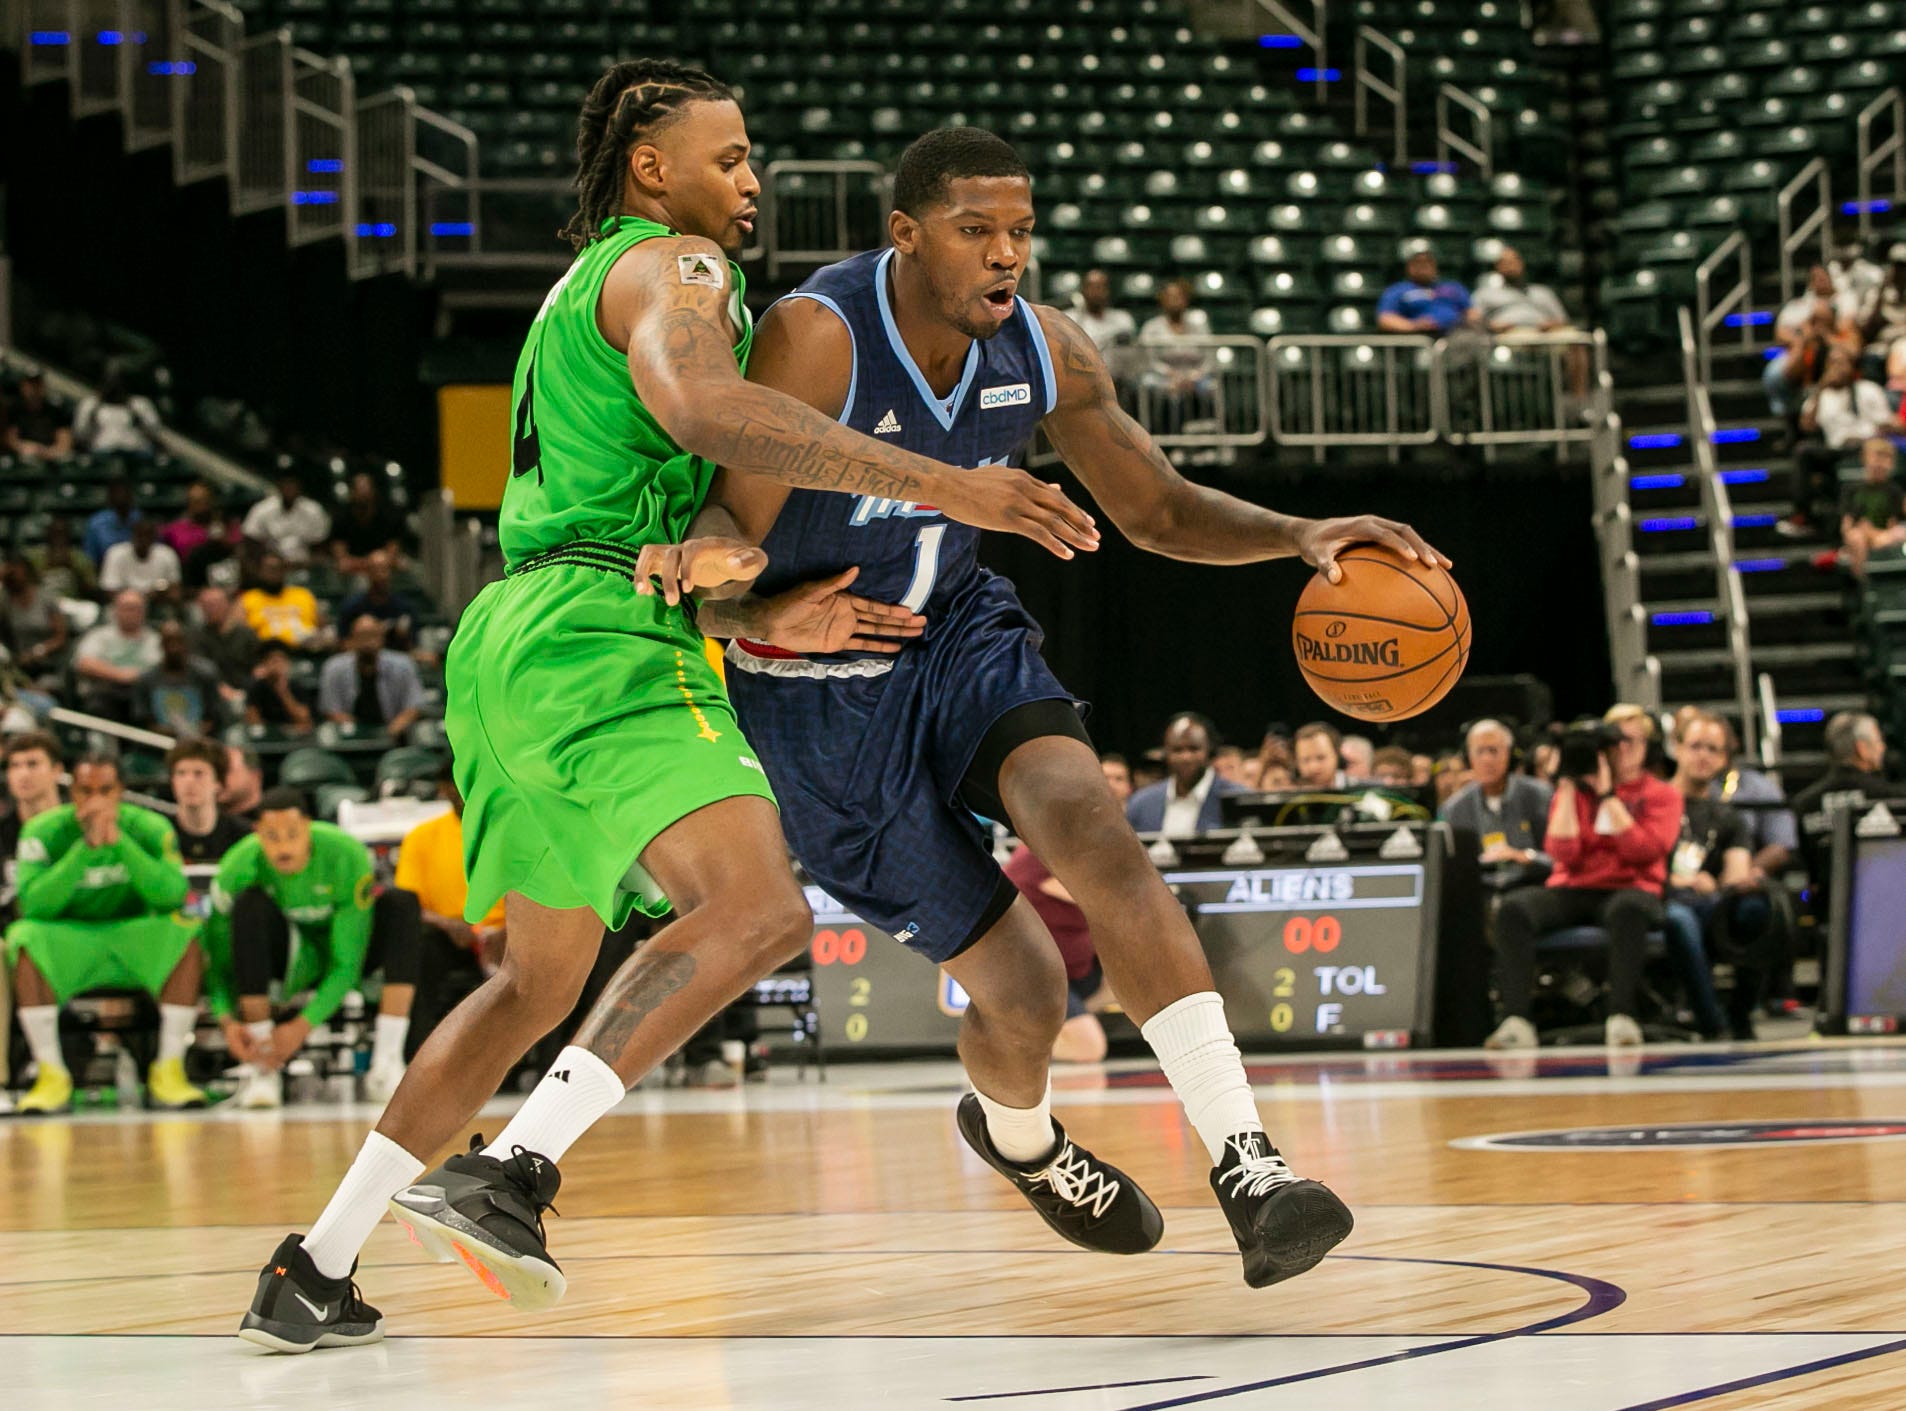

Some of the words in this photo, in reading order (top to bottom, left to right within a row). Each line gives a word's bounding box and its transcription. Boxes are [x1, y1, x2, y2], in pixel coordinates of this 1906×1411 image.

[983, 389, 1028, 405] cbdMD
[513, 343, 544, 487] 4
[873, 424, 902, 434] adidas
[898, 523, 948, 614] 1
[1296, 632, 1402, 667] SPALDING
[1226, 873, 1354, 904] ALIENS
[812, 928, 867, 966] 00
[1283, 915, 1342, 955] 00
[850, 976, 871, 1007] 2
[1273, 967, 1296, 998] 2
[1313, 965, 1388, 996] TOL
[845, 1012, 868, 1042] 0
[1270, 1002, 1294, 1033] 0
[1315, 1002, 1343, 1034] F
